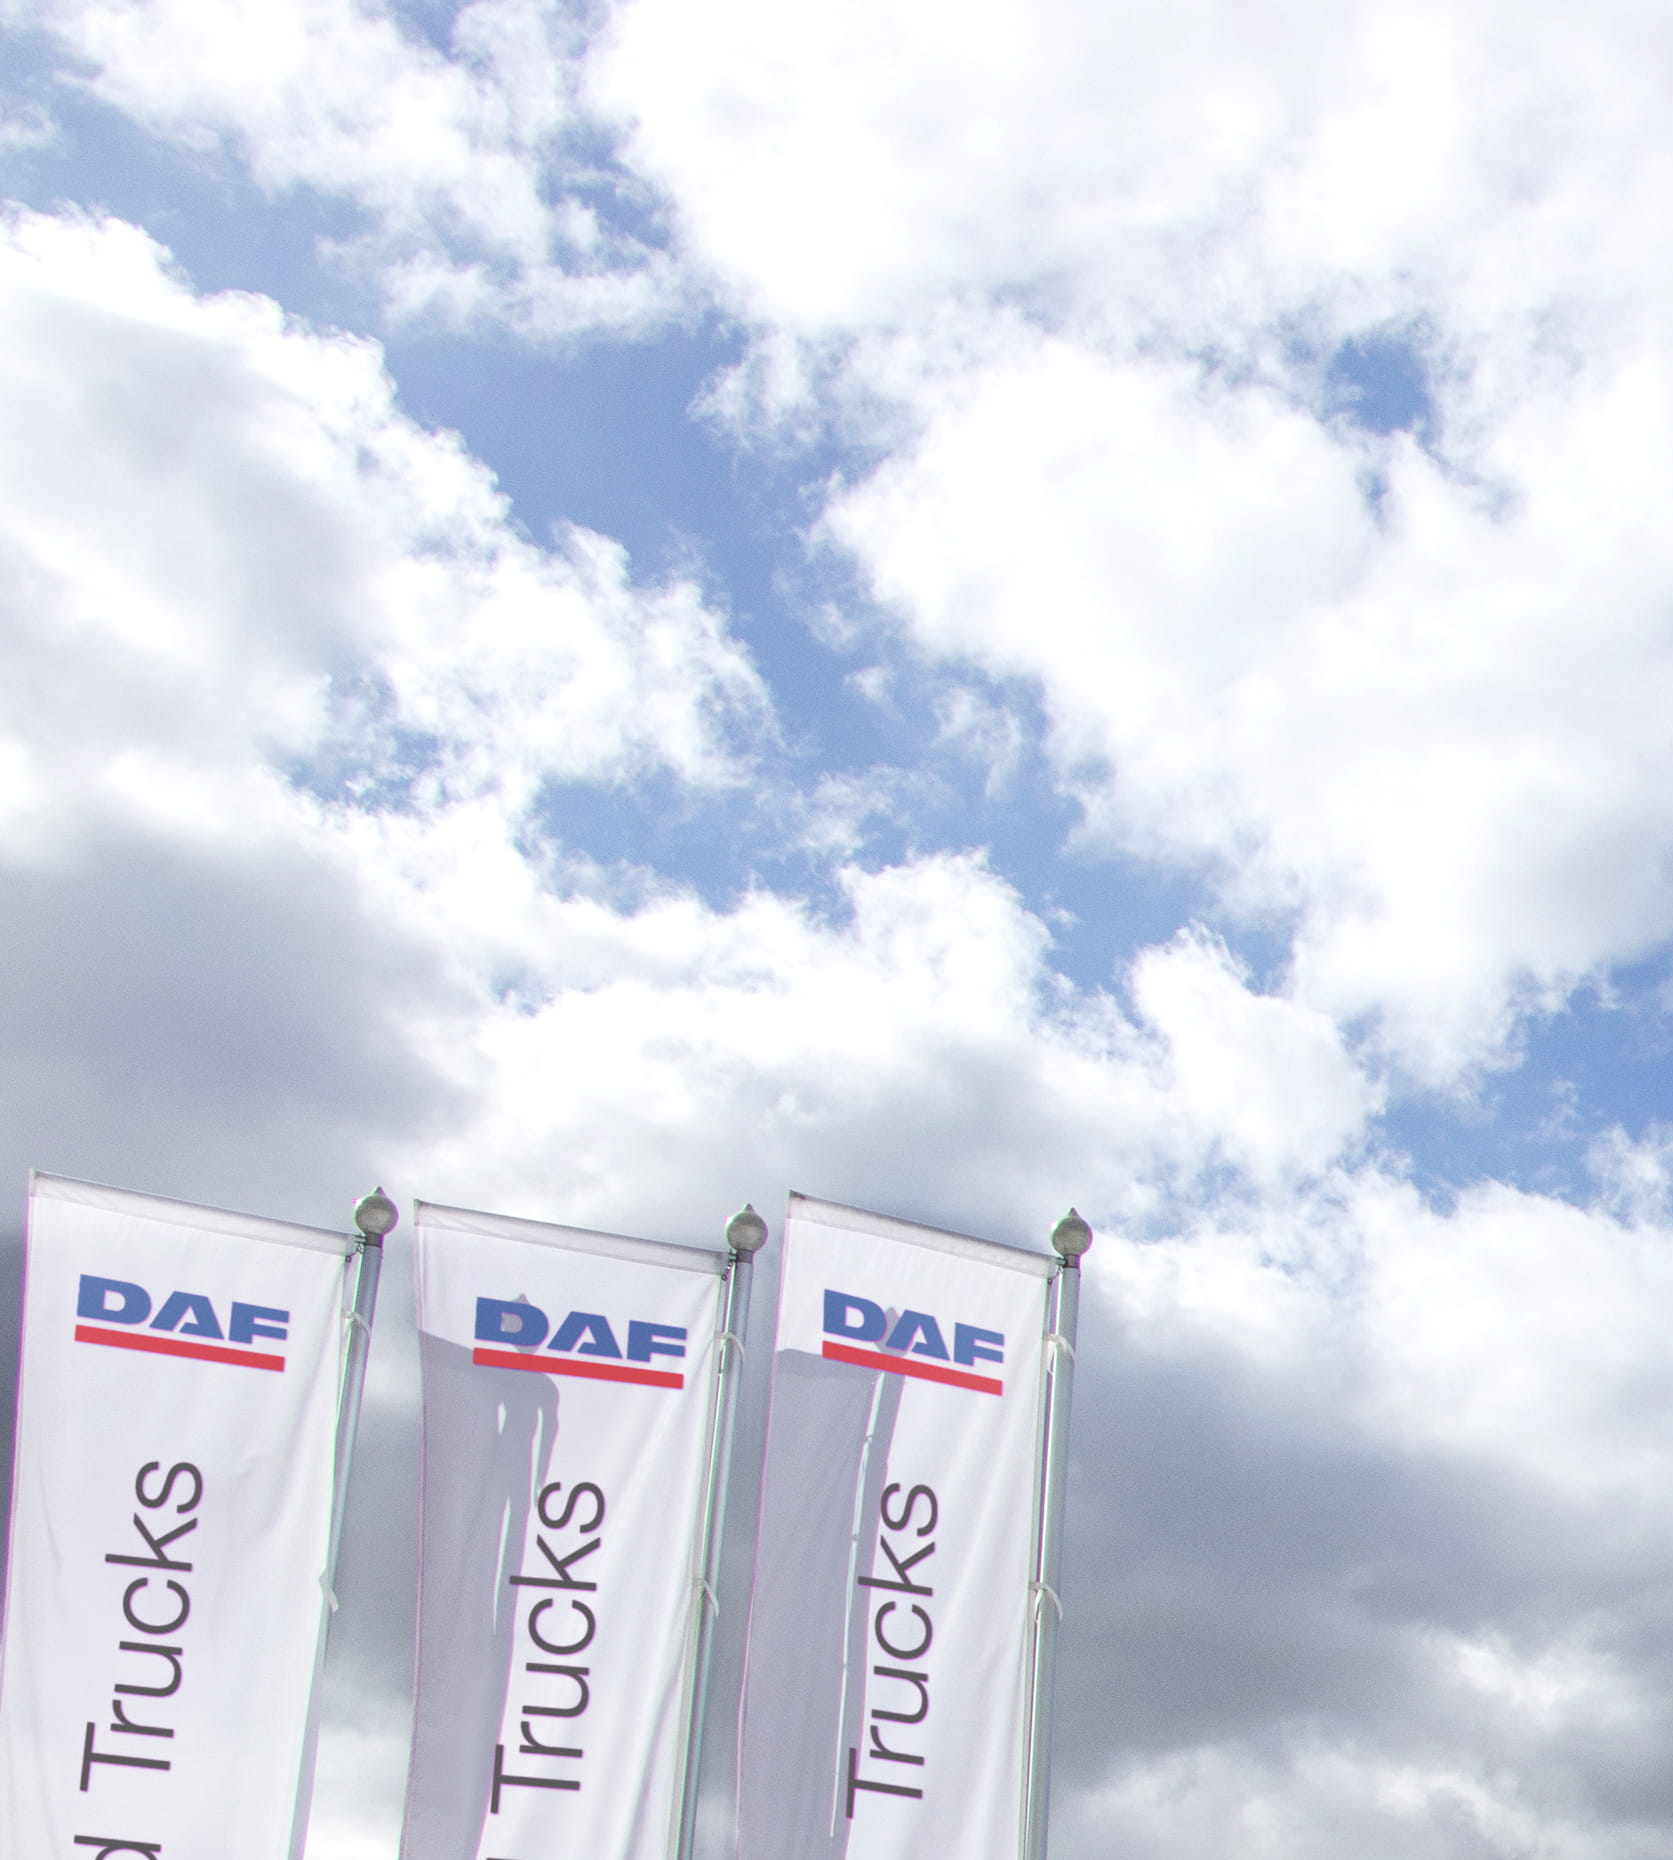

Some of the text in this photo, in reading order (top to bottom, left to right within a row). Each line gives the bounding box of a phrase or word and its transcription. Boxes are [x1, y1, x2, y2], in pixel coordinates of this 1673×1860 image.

[77, 1274, 290, 1343] DAF
[474, 1296, 688, 1363] DAF
[822, 1288, 1004, 1366] DAF
[80, 1460, 203, 1793] Trucks
[490, 1481, 606, 1815] Trucks
[845, 1482, 939, 1820] Trucks
